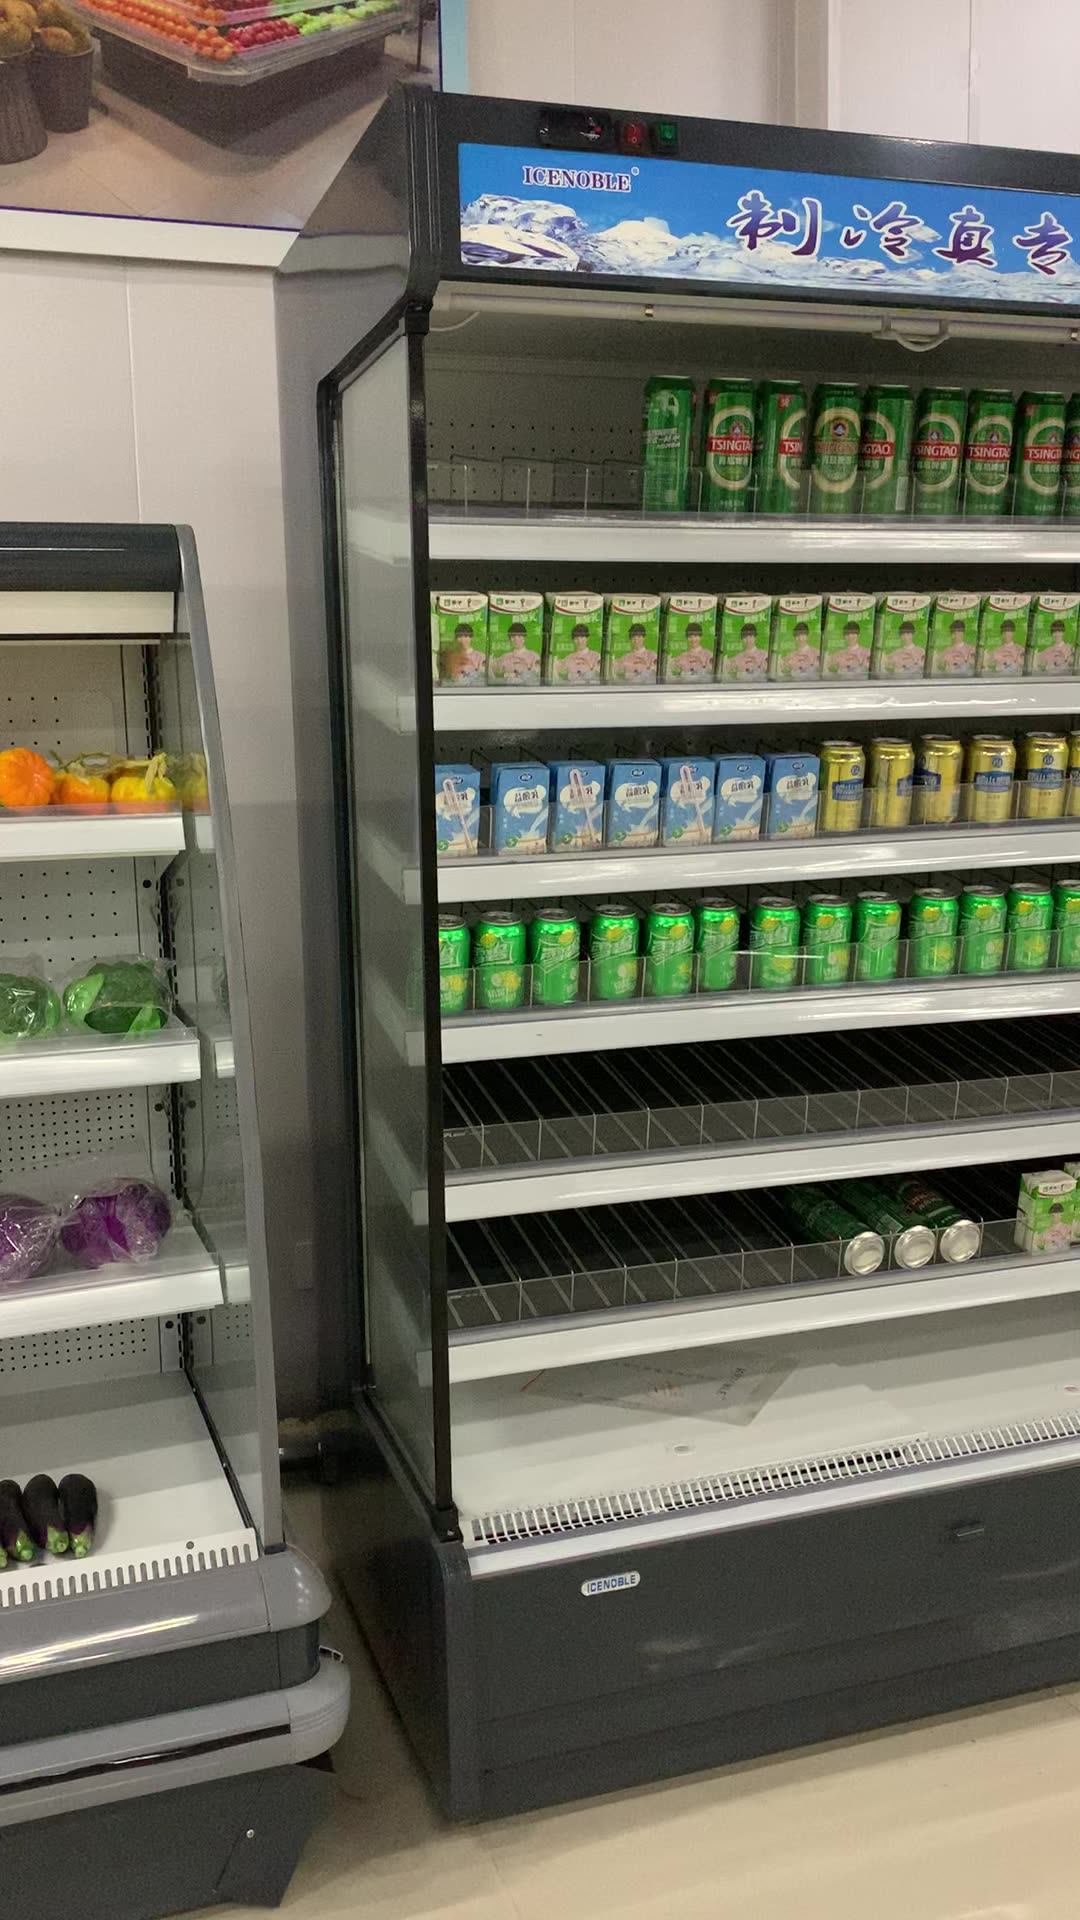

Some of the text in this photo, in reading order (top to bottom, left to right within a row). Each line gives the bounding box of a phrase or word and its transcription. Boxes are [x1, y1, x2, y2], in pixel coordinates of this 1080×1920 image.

[523, 167, 631, 191] ICENOBLE
[728, 191, 1073, 275] 制冷真专
[711, 439, 752, 451] TSINGTA
[587, 1575, 636, 1593] ICENOBLE
